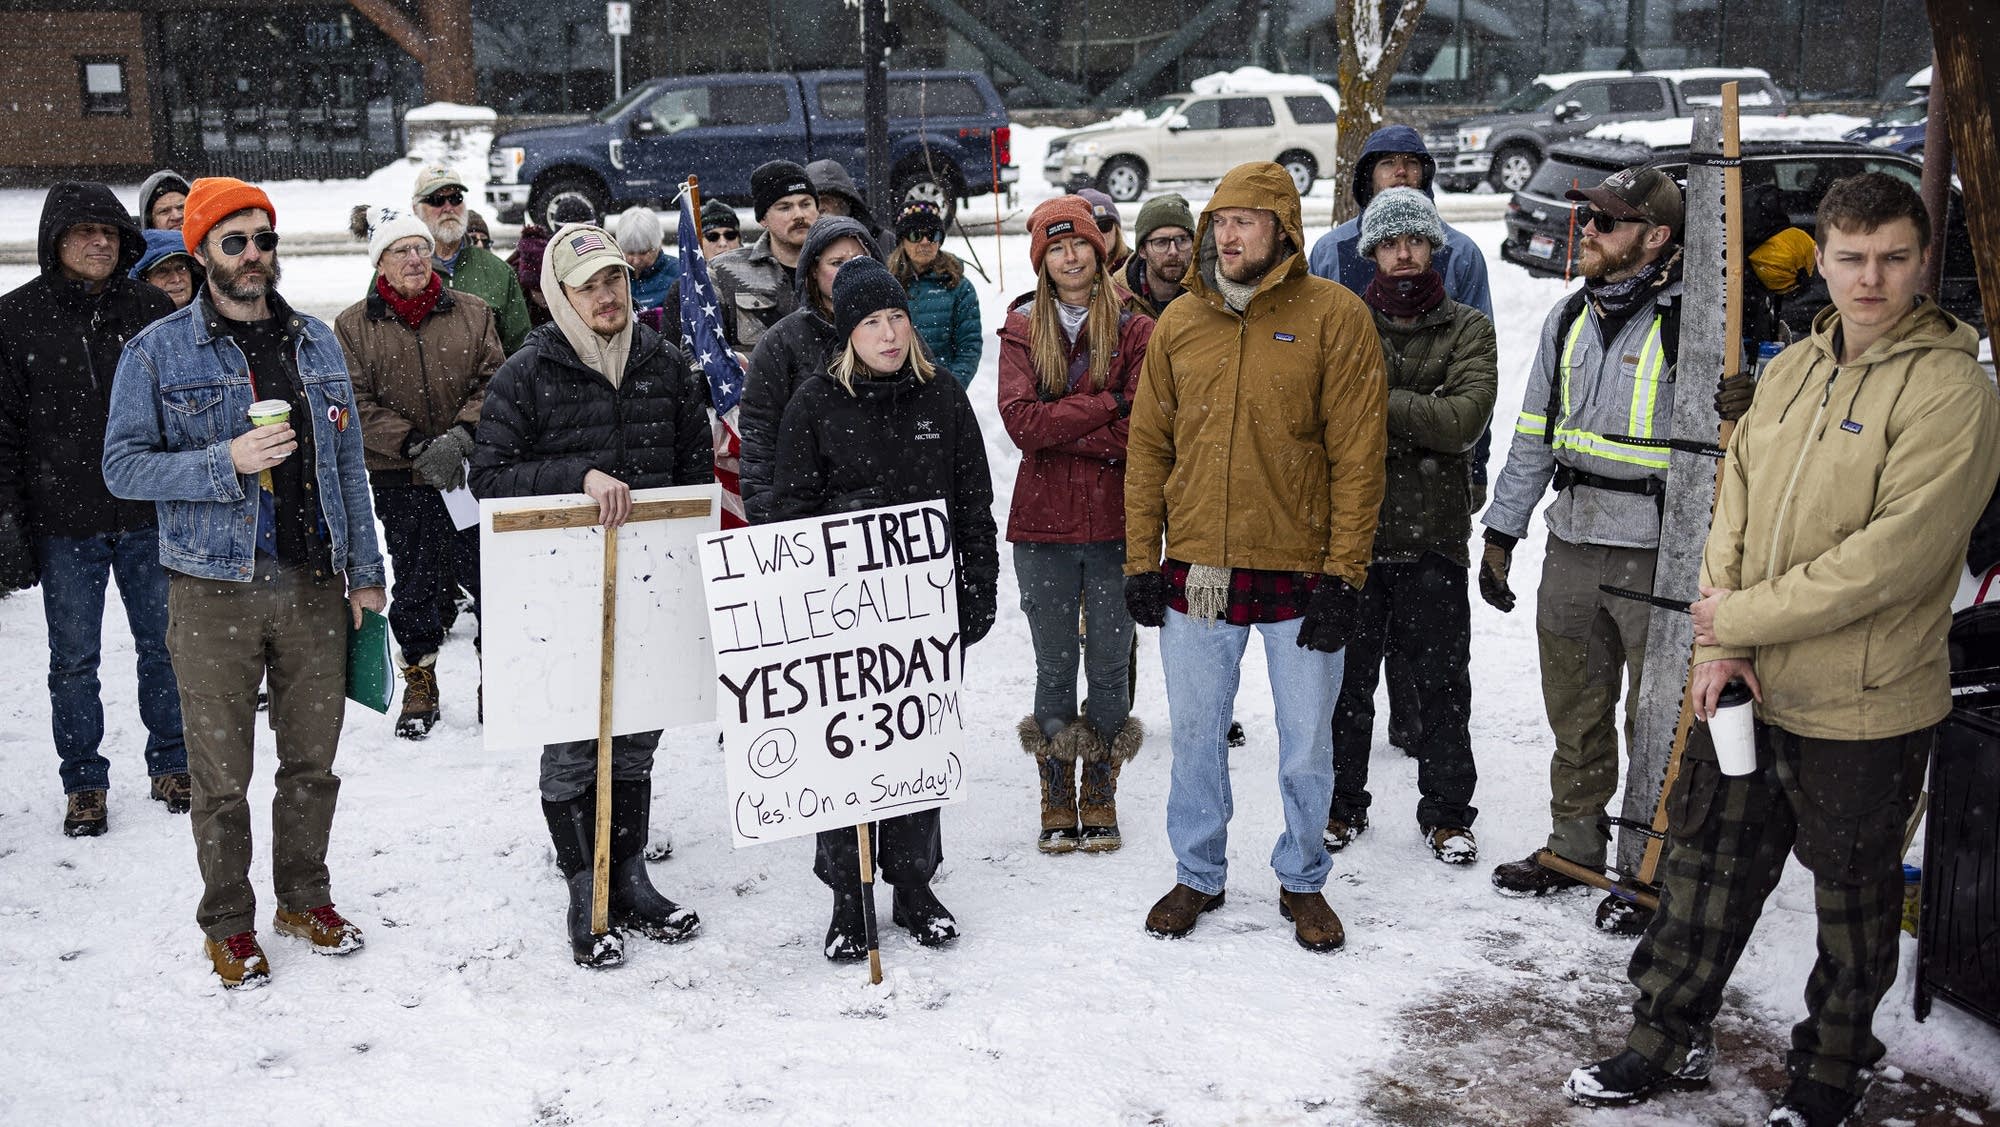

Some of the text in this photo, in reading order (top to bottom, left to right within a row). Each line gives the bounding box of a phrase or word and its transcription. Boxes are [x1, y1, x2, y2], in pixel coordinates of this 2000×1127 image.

[707, 507, 952, 583] I WAS FIRED
[714, 568, 954, 655] ILLEGALLY
[719, 632, 961, 724] YESTERDAY
[748, 727, 798, 779] @
[799, 787, 836, 819] On
[845, 791, 862, 807] a
[870, 751, 963, 806] Sunday!)
